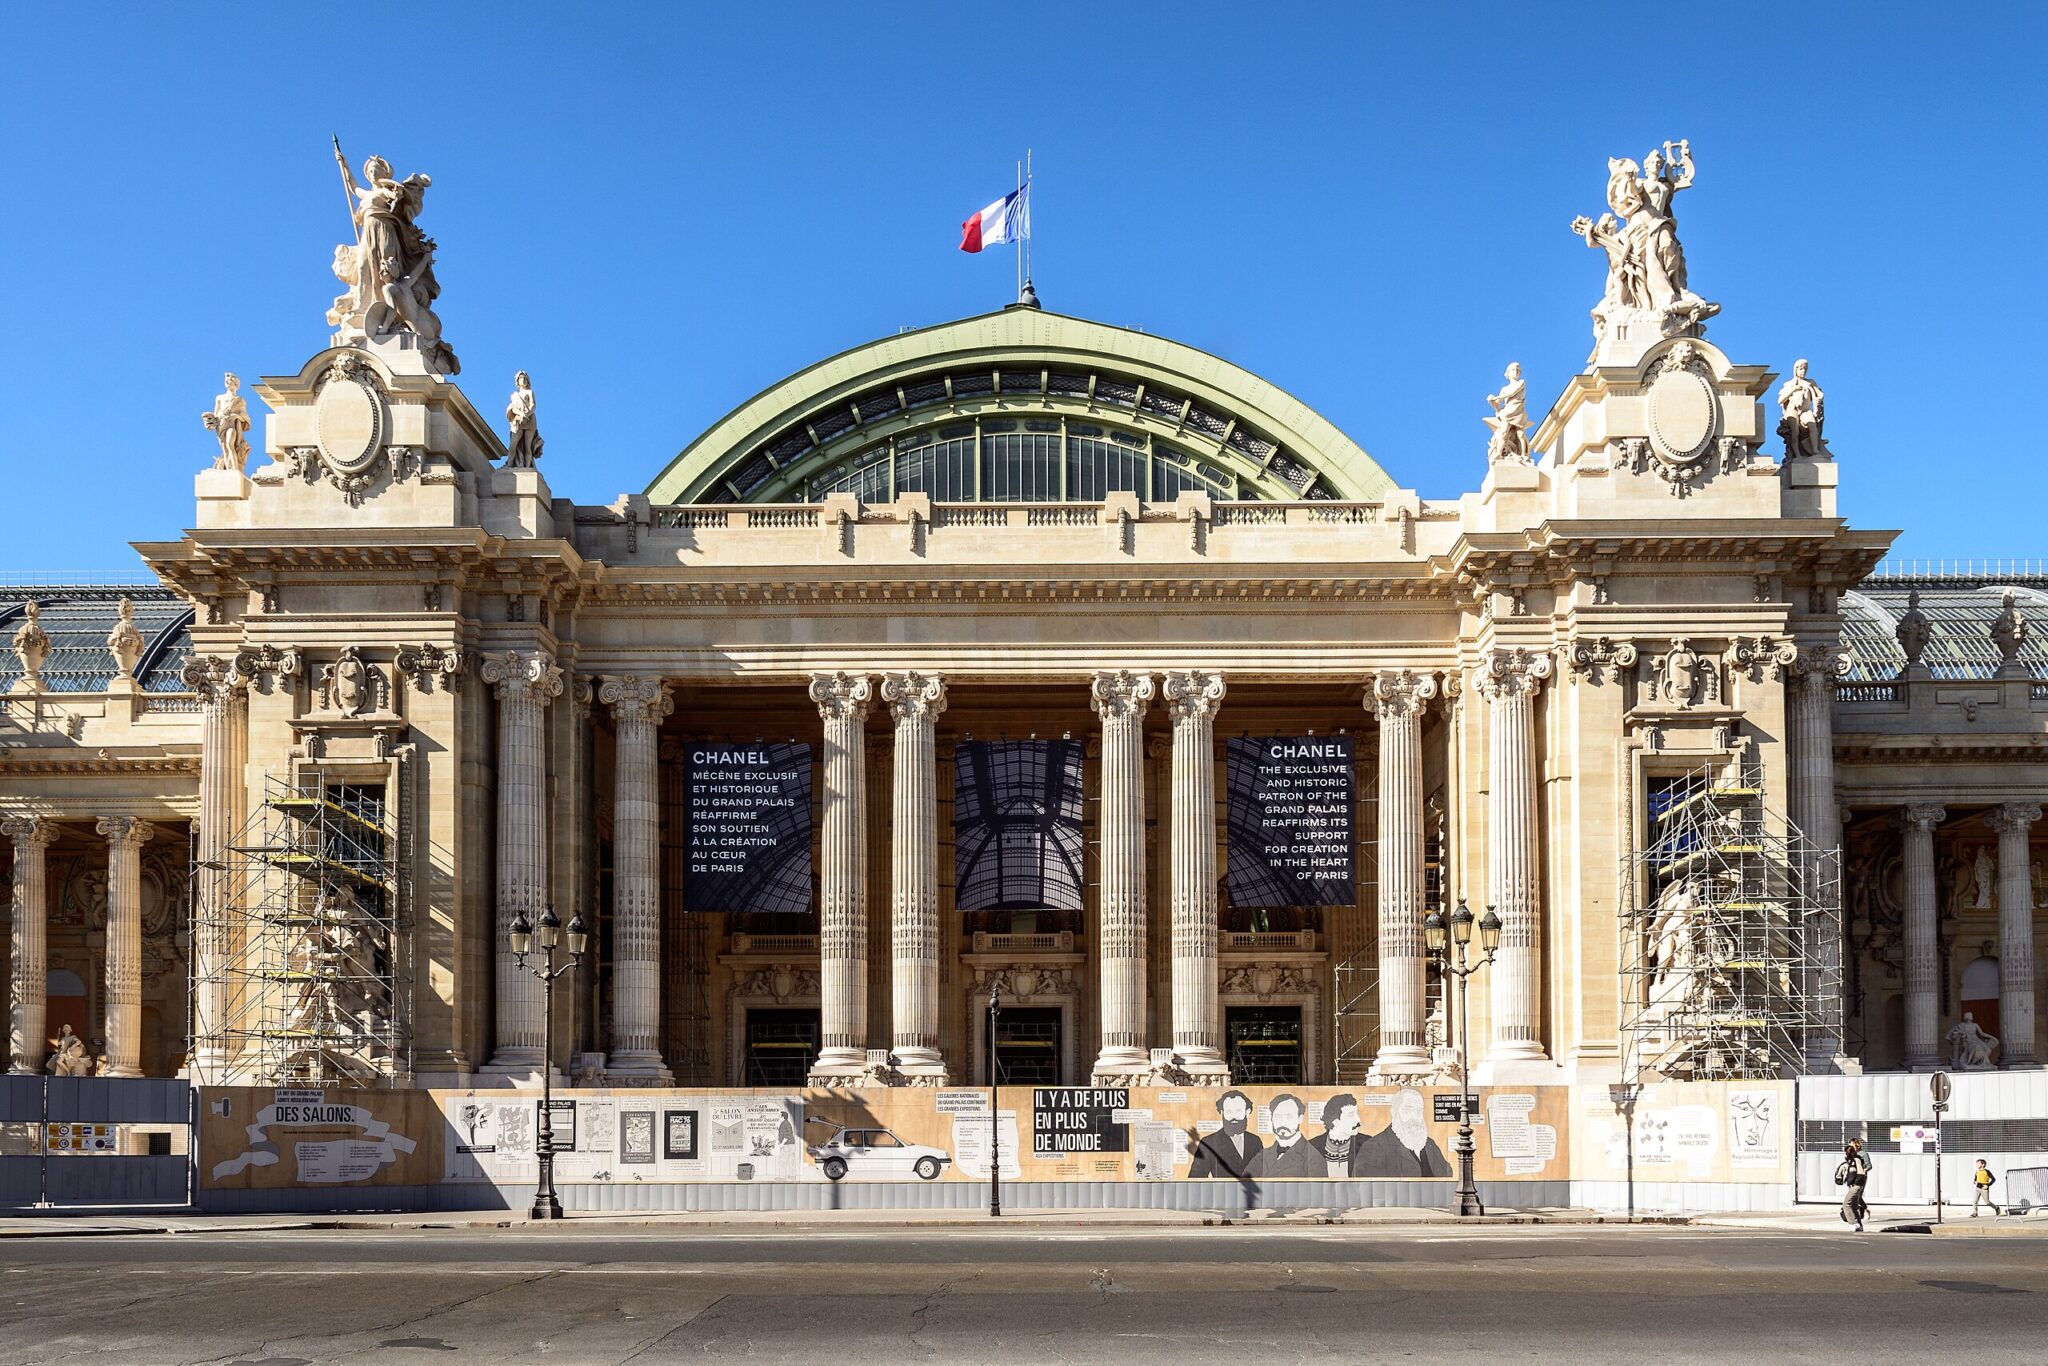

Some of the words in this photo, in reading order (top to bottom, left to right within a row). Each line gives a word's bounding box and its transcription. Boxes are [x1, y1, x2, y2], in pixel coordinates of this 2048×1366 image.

[1271, 745, 1347, 758] CHANEL
[693, 752, 769, 764] CHANEL
[1259, 766, 1281, 774] THE
[1285, 766, 1347, 774] EXCLUSIVE
[693, 770, 741, 780] MÉCÈNE
[1295, 779, 1347, 787] HISTORIC
[1259, 793, 1303, 801] PATRON
[1307, 792, 1322, 800] OF
[1325, 792, 1347, 800] THE
[1265, 806, 1304, 814] GRAND
[1308, 805, 1347, 813] PALAIS
[693, 810, 757, 819] RÉAFFIRME
[1263, 819, 1327, 827] REAFFIRMS
[693, 825, 716, 833] SON
[720, 825, 769, 833] SOUTIEN
[1295, 832, 1348, 840] SUPPORT
[692, 836, 700, 846] À
[703, 838, 717, 846] LA
[721, 836, 777, 846] CRÉATION
[1292, 845, 1348, 853] CREATION
[711, 851, 746, 859] CŒUR
[1271, 859, 1281, 867] IN
[1297, 872, 1312, 880] OF
[1036, 1091, 1046, 1107] IL
[1049, 1091, 1058, 1107] Y
[1061, 1091, 1070, 1107] A
[1075, 1091, 1090, 1107] DE
[1094, 1091, 1125, 1108] PLUS
[276, 1107, 298, 1122] DES
[303, 1107, 355, 1122] SALONS.
[1036, 1113, 1051, 1129] EN
[1056, 1112, 1087, 1129] PLUS
[1036, 1134, 1051, 1150] DE
[1055, 1134, 1101, 1150] MONDE
